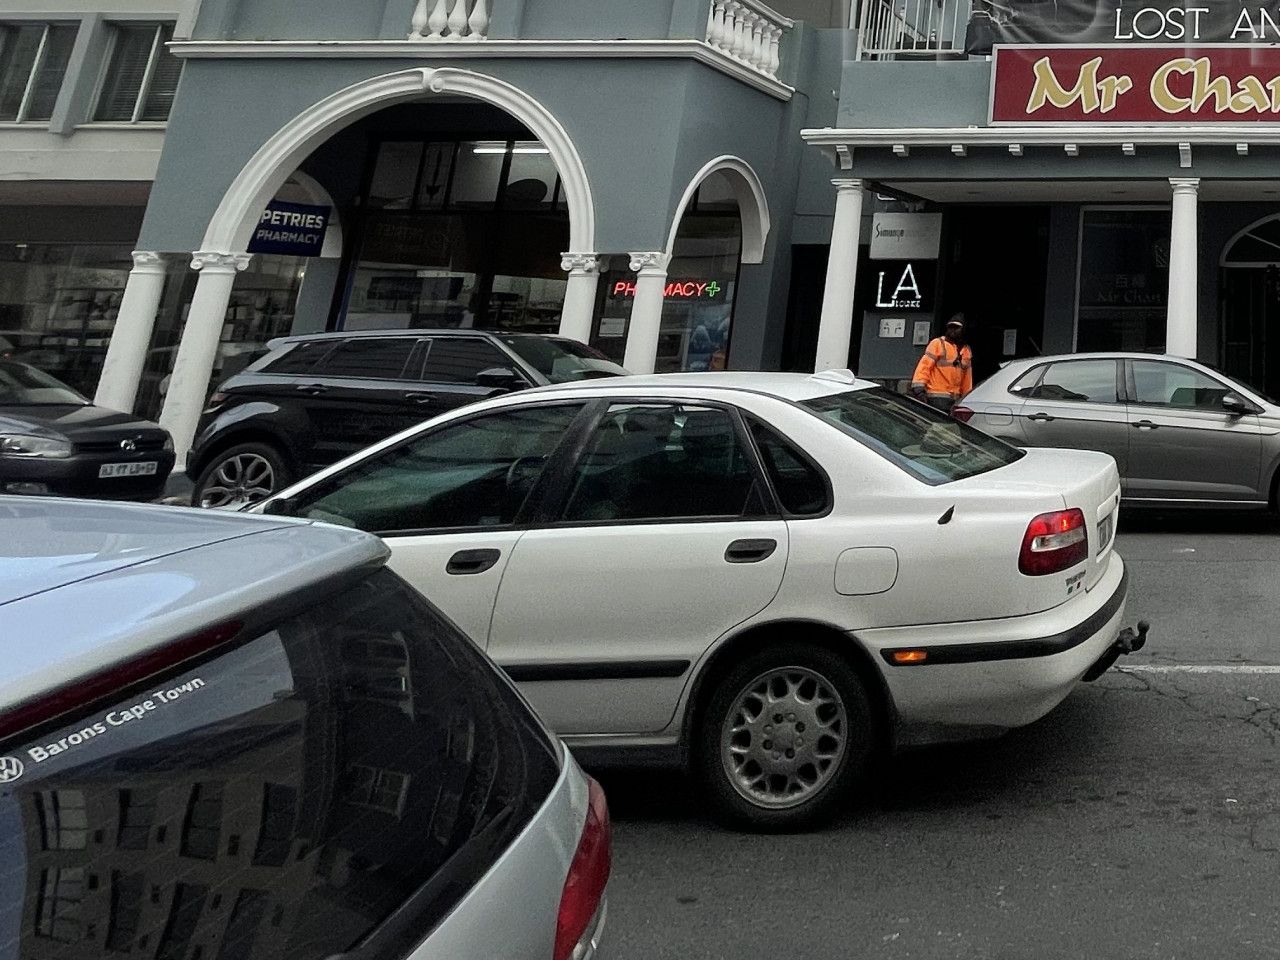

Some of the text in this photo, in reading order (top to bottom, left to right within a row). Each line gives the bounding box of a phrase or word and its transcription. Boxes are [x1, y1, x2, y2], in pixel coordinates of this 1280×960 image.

[1113, 7, 1210, 40] LOST
[1026, 56, 1133, 114] Mr
[260, 209, 325, 229] PETRIES
[256, 229, 321, 245] PHARMACY
[612, 280, 708, 297] PHMACY
[27, 676, 206, 763] Barons Cape Town
